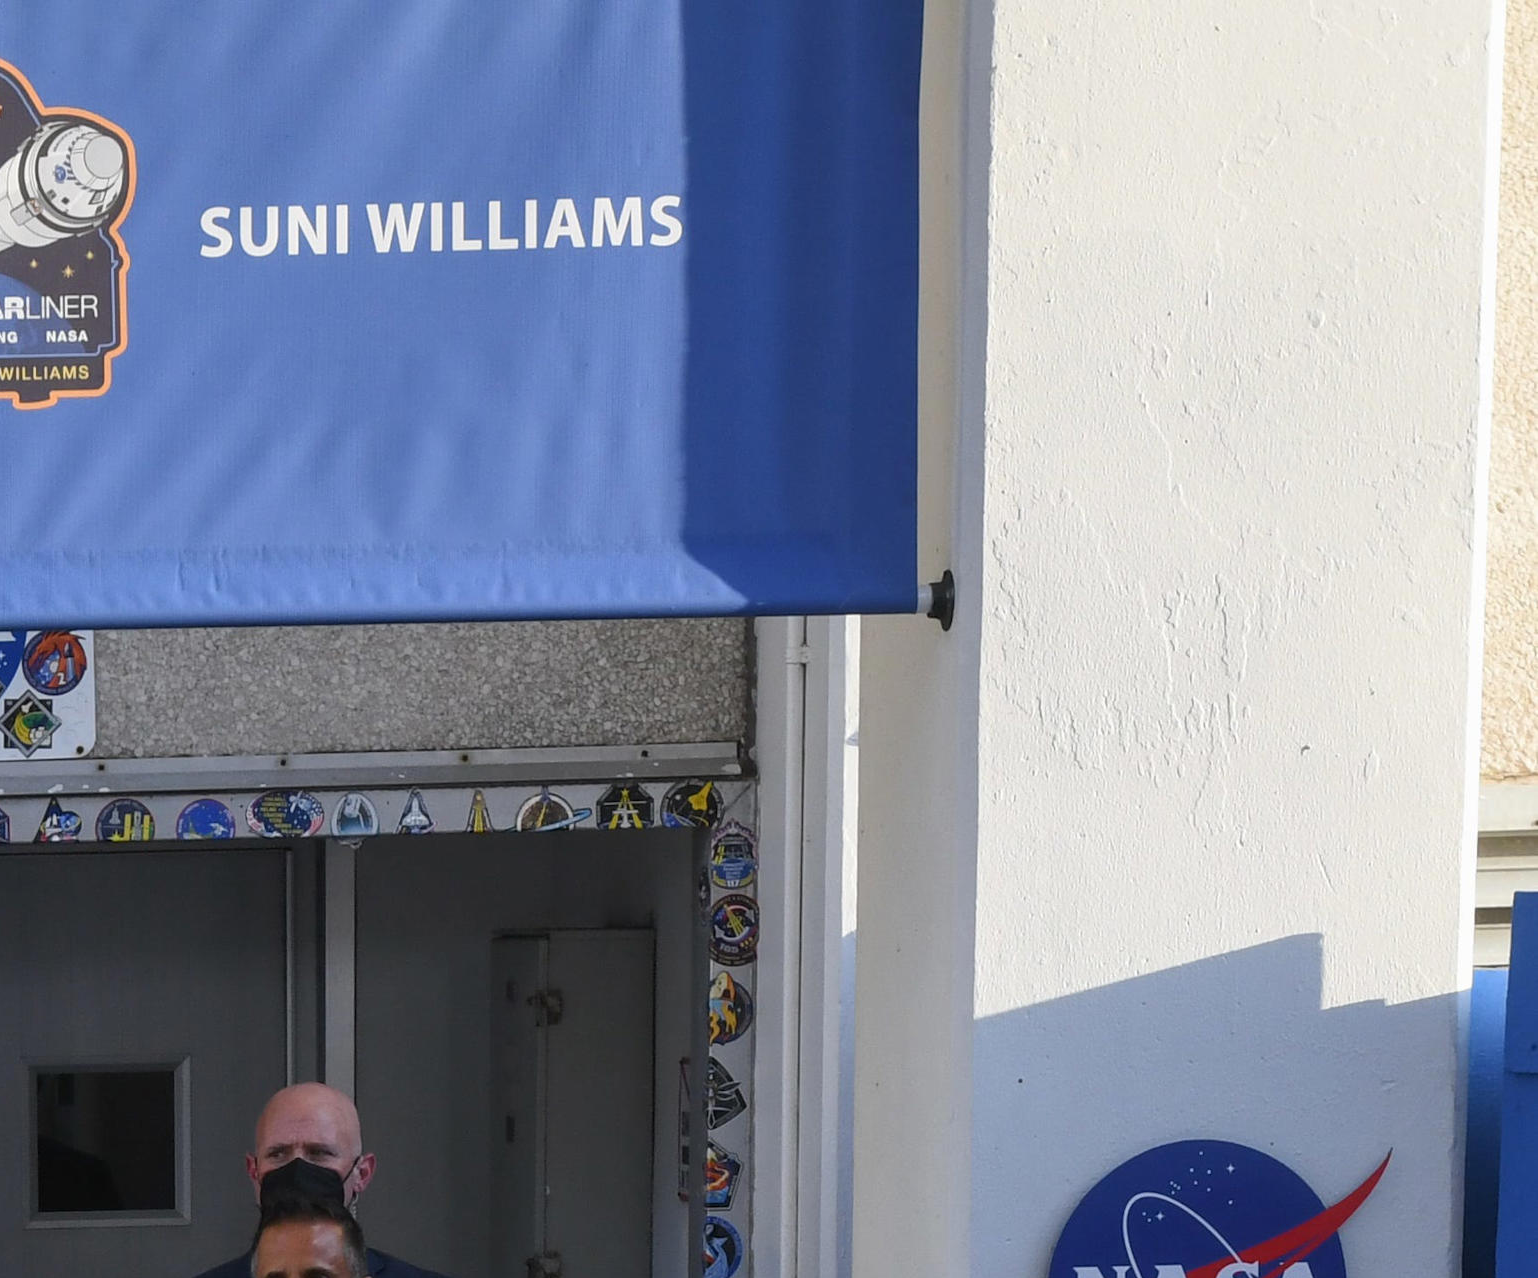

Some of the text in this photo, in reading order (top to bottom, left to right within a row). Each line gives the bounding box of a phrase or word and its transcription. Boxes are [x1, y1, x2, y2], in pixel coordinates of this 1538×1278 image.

[199, 195, 683, 257] SUNI WILLIAMS
[46, 330, 88, 343] NASA
